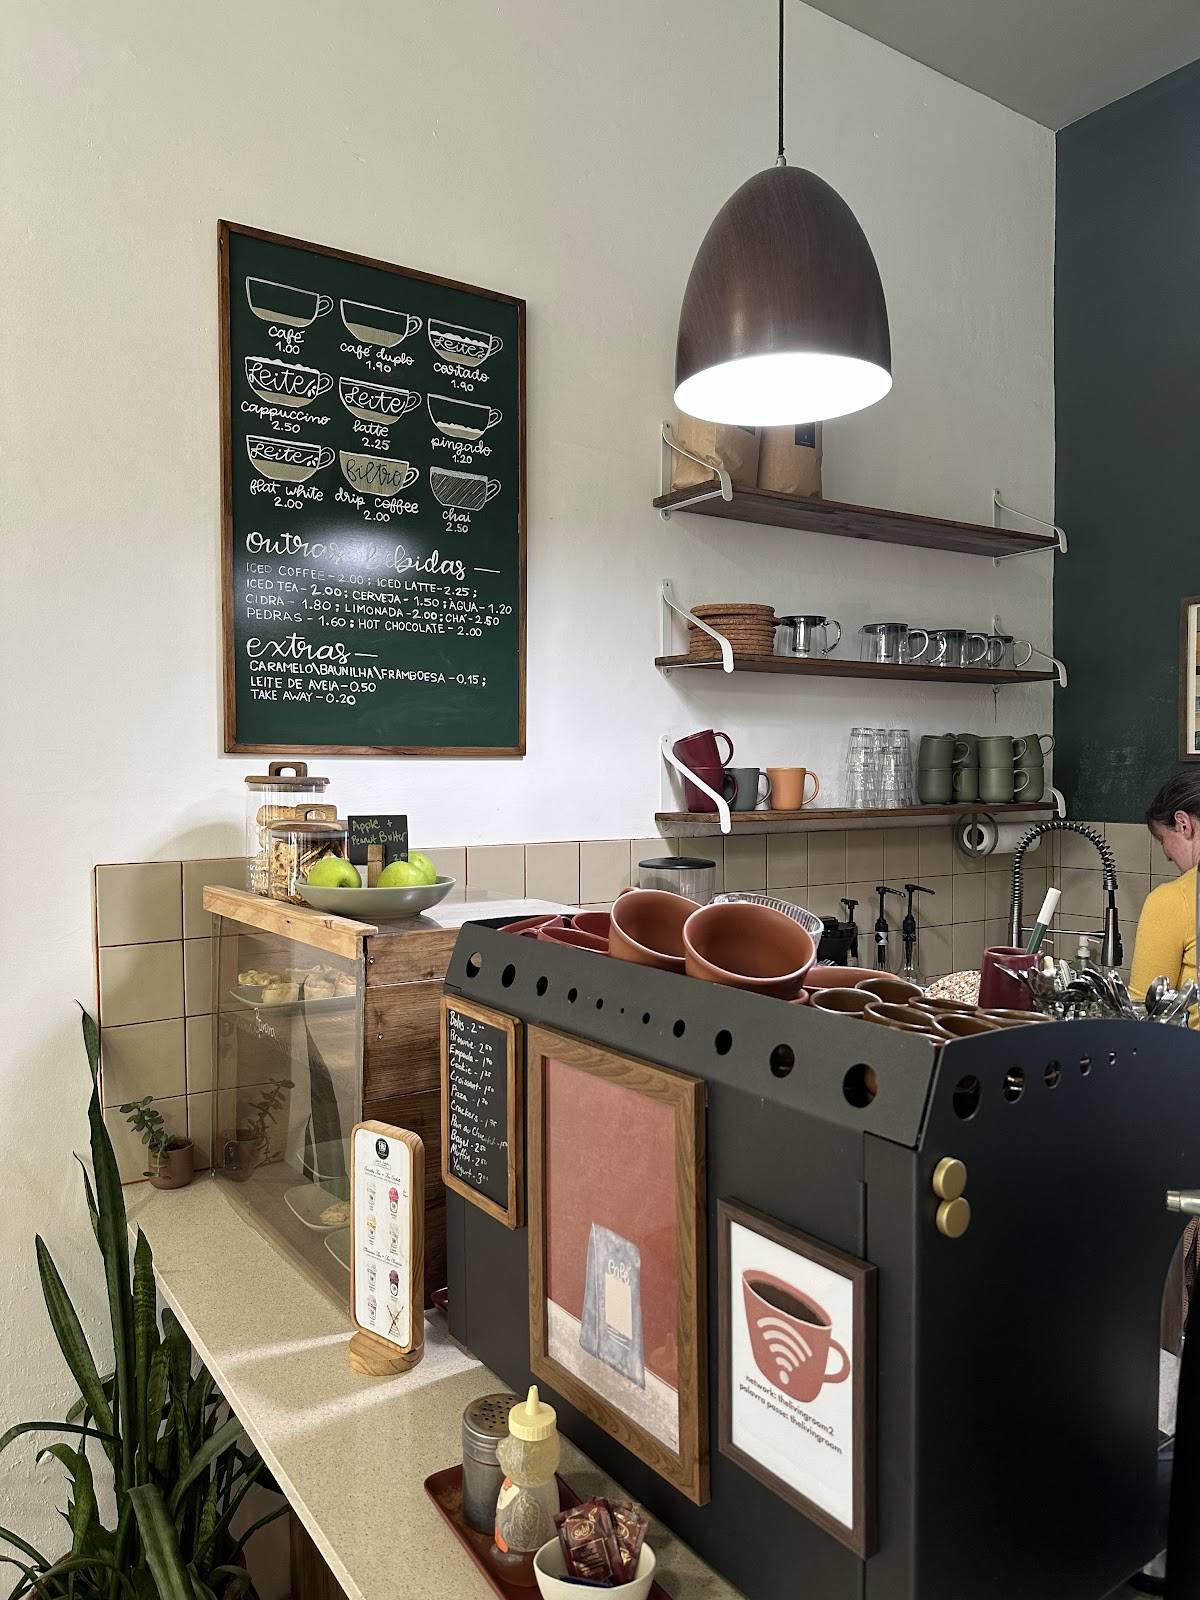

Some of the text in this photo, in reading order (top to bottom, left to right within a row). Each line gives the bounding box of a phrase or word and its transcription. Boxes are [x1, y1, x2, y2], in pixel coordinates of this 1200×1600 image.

[268, 325, 305, 345] café
[275, 340, 300, 355] 1.00
[340, 342, 415, 366] café duplo
[366, 359, 392, 373] 1.90
[433, 362, 490, 382] cortado
[248, 362, 309, 394] Leite
[450, 379, 474, 392] 1.90
[345, 386, 405, 414] Leite
[241, 401, 331, 425] cappuccino
[272, 421, 301, 434] 2.50
[353, 419, 389, 437] latte
[250, 443, 307, 464] Leite
[361, 438, 389, 451] 2.25
[431, 437, 492, 459] pingado
[452, 453, 472, 464] 1.20
[249, 479, 324, 502] flat white
[274, 497, 303, 510] 2.00
[335, 487, 419, 515] drip coffee
[363, 510, 390, 522] 2.00
[442, 507, 471, 523] chai
[445, 522, 469, 533] 2.50
[246, 562, 273, 574] ICED
[377, 578, 401, 589] ICED
[246, 578, 273, 590] ICED
[247, 607, 303, 623] PEDRAS
[358, 618, 380, 629] HOT
[246, 633, 351, 664] extras
[251, 677, 282, 689] LEITE
[287, 679, 303, 689] DE
[250, 689, 278, 700] TAKE
[282, 691, 313, 702] AWAY
[352, 819, 380, 834] Apple
[351, 830, 407, 845] Peanut Butter
[450, 1057, 472, 1075] Cookie
[746, 1375, 834, 1436] network: thelivingroom2
[740, 1383, 843, 1454] palavra passe: thelivingroom
